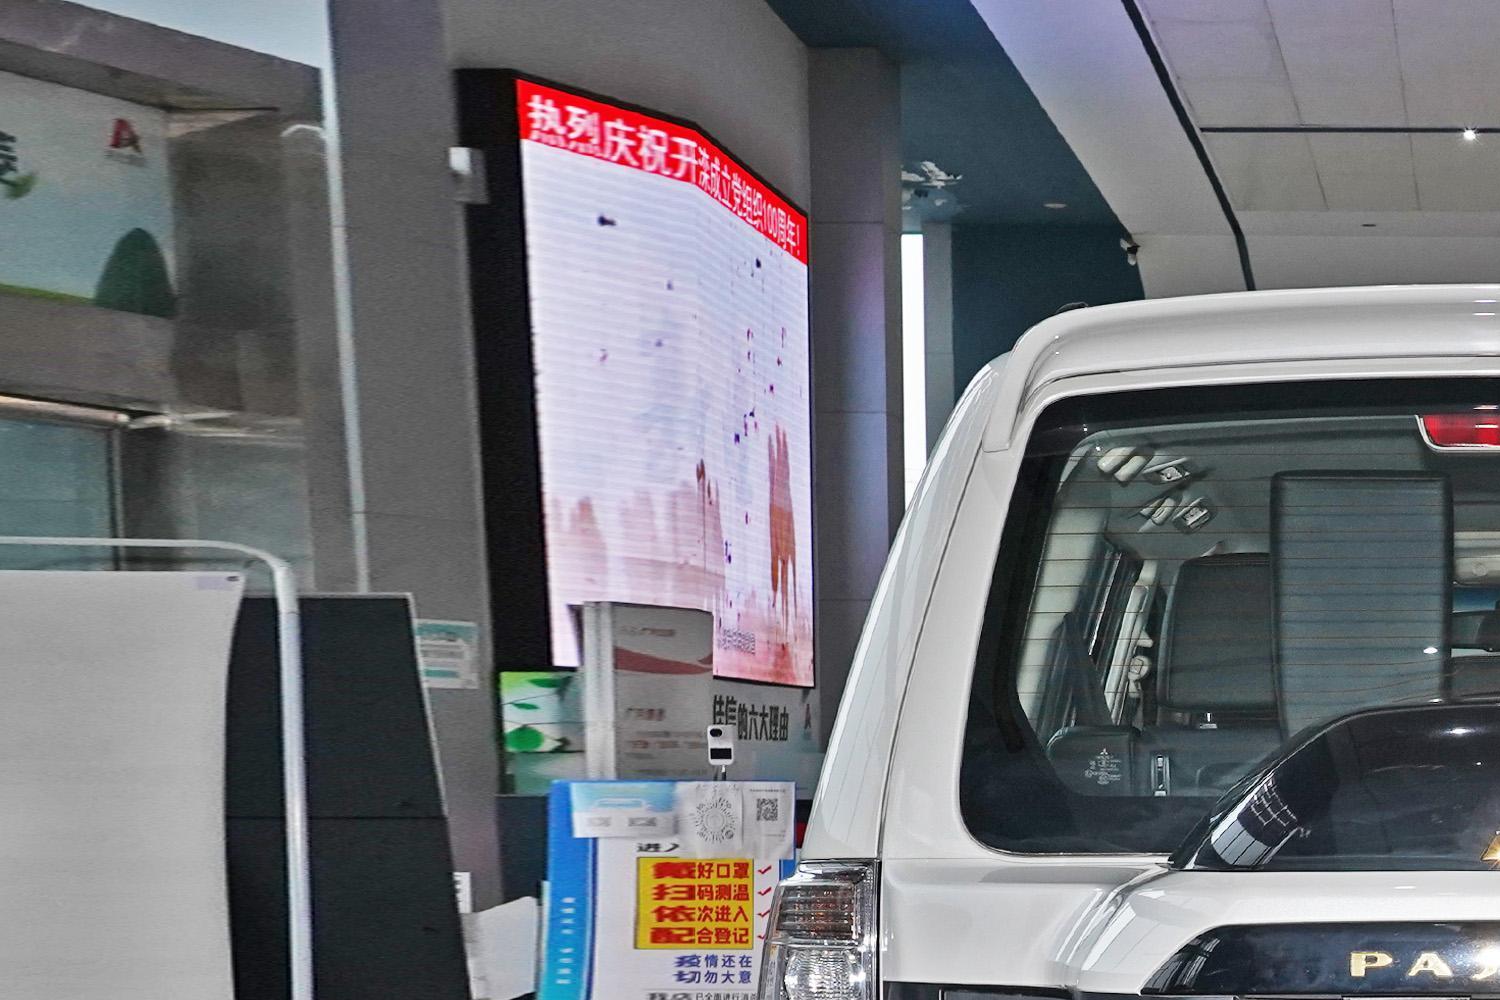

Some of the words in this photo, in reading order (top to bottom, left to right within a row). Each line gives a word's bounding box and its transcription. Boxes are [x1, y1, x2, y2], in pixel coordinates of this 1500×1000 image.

[652, 862, 750, 879] 戴好口罩
[652, 884, 750, 901] 扫码测温
[651, 906, 750, 922] 依次进入
[650, 927, 750, 944] 配合登记
[673, 954, 753, 968] 疫情还在
[673, 971, 752, 984] 切勿大意
